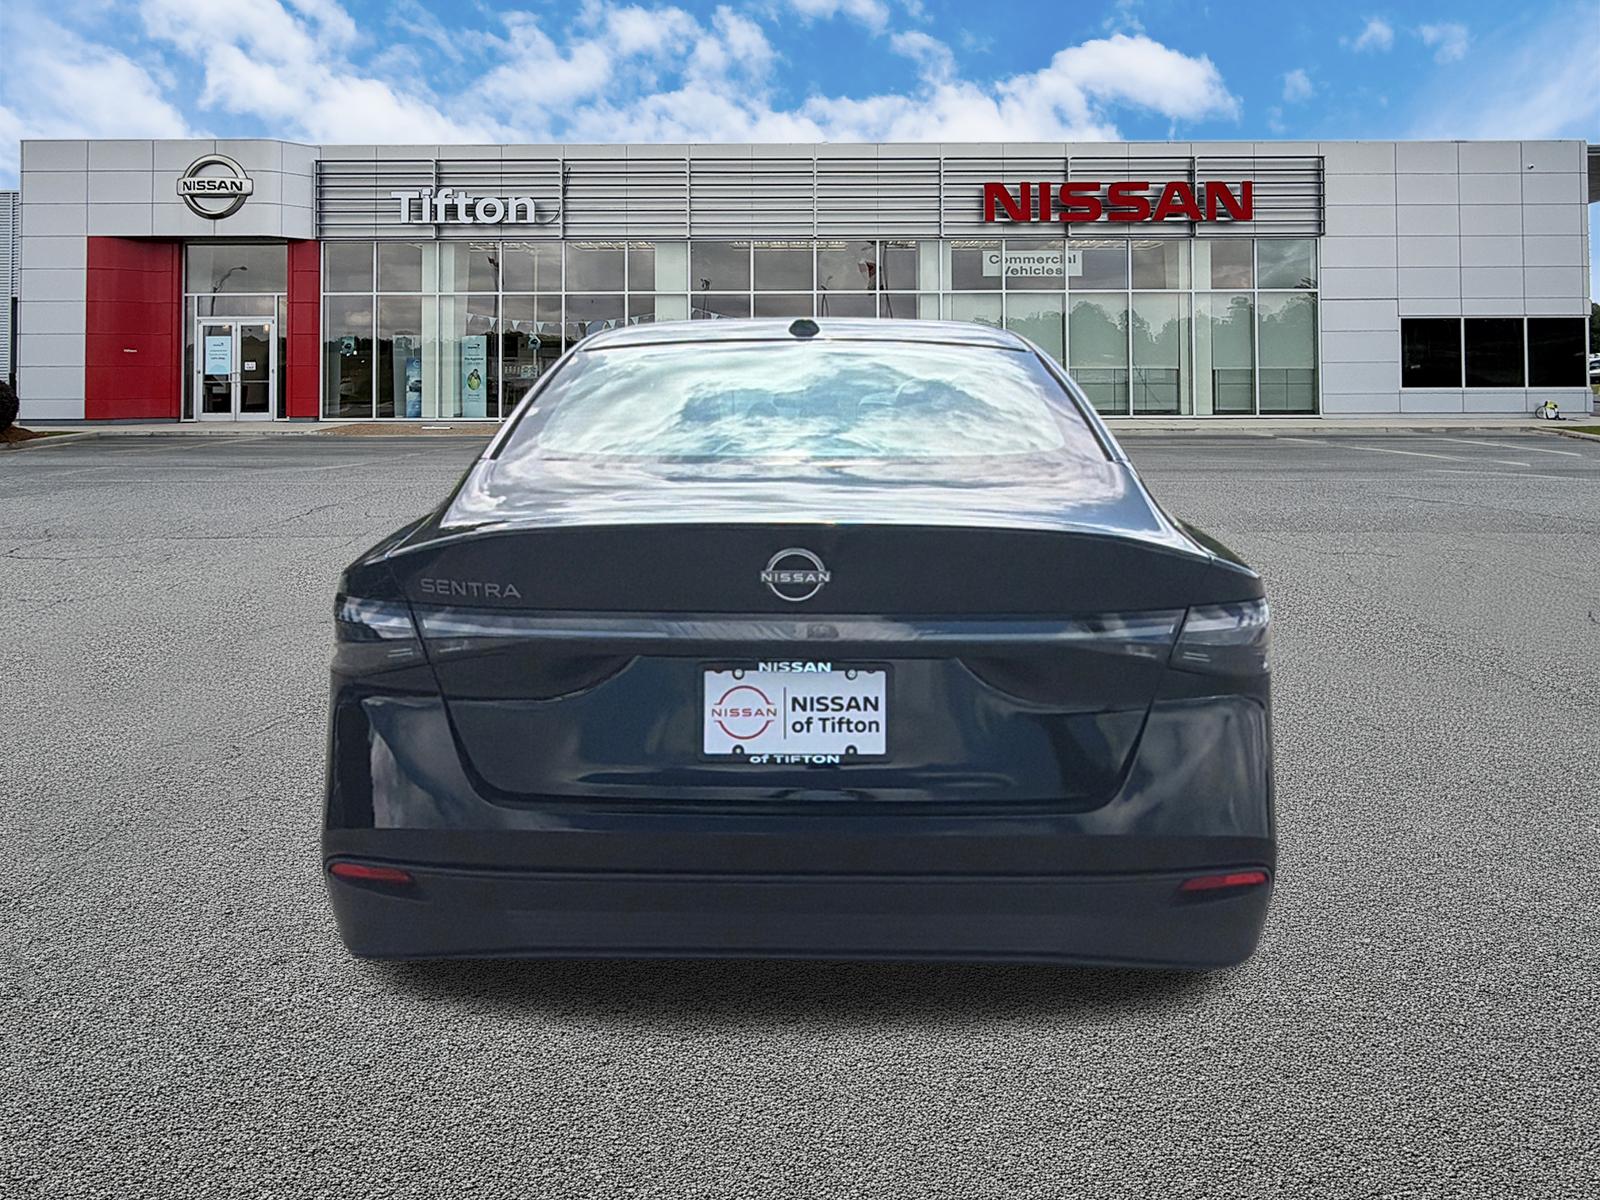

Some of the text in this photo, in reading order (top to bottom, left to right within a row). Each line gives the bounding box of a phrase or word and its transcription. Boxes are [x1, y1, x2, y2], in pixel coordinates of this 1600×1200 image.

[182, 180, 243, 191] NISSAN
[391, 187, 536, 224] Tifton
[983, 180, 1254, 222] NISSAN
[761, 571, 831, 583] NISSAN
[420, 578, 522, 599] SENTRA
[758, 662, 832, 673] NISSAN
[791, 696, 879, 712] NISSAN
[711, 708, 777, 717] NISSAN
[791, 717, 880, 733] of Tifton
[749, 755, 840, 764] of TIFTON
